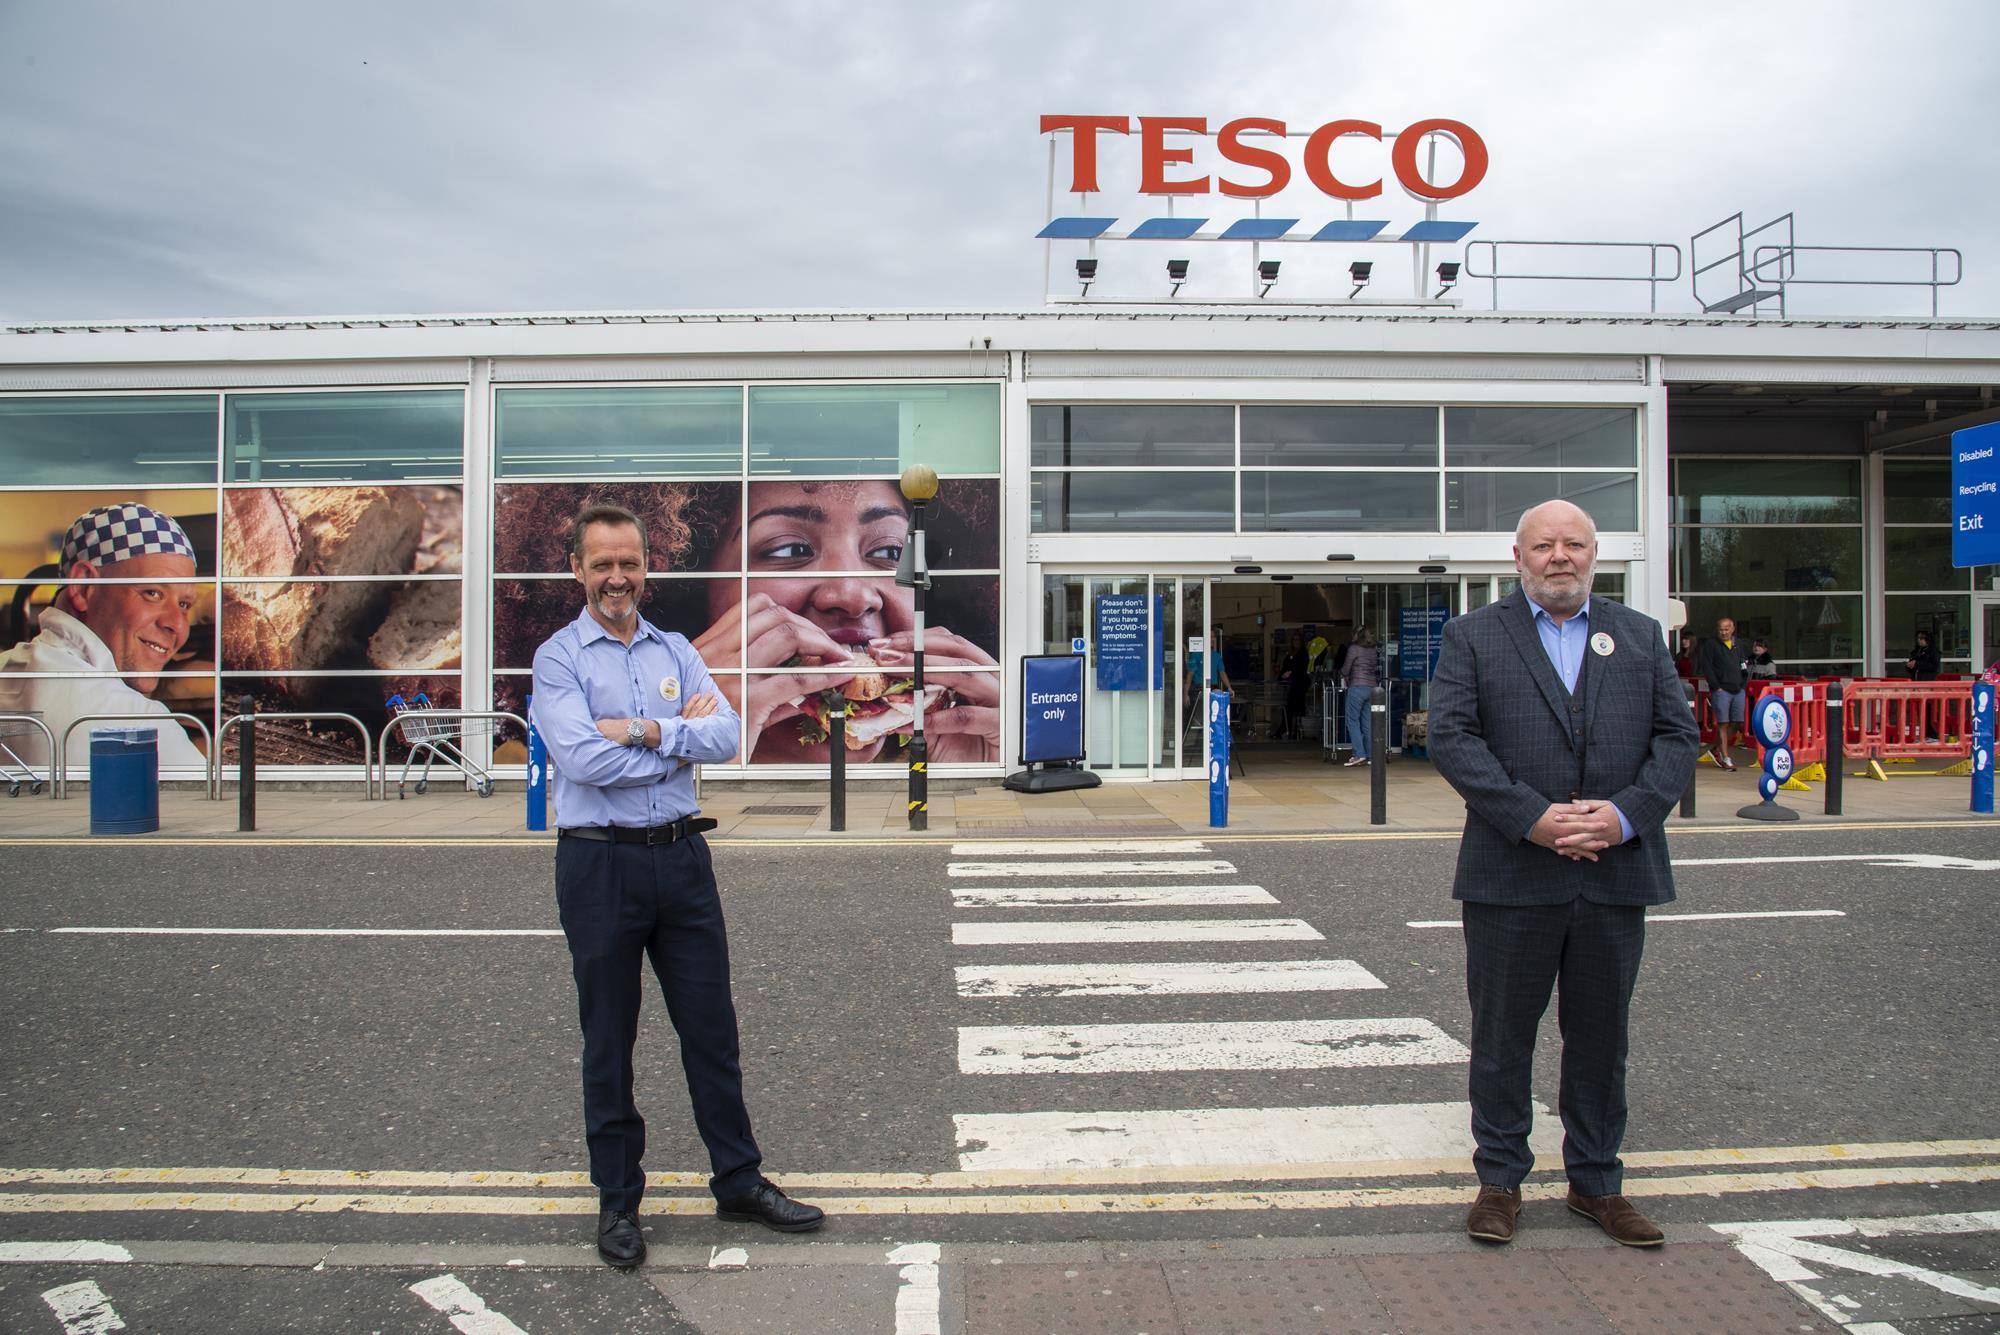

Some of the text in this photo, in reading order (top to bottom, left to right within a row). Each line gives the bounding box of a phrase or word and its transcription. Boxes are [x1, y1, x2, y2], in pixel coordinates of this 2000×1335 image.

[1040, 115, 1489, 200] TESCO
[1959, 447, 1993, 462] Disabled
[1959, 482, 1997, 496] Recycling
[1959, 513, 1984, 531] Exit
[1121, 607, 1134, 615] the
[1107, 616, 1121, 624] you
[1031, 693, 1078, 704] Entrance
[1043, 707, 1065, 721] only
